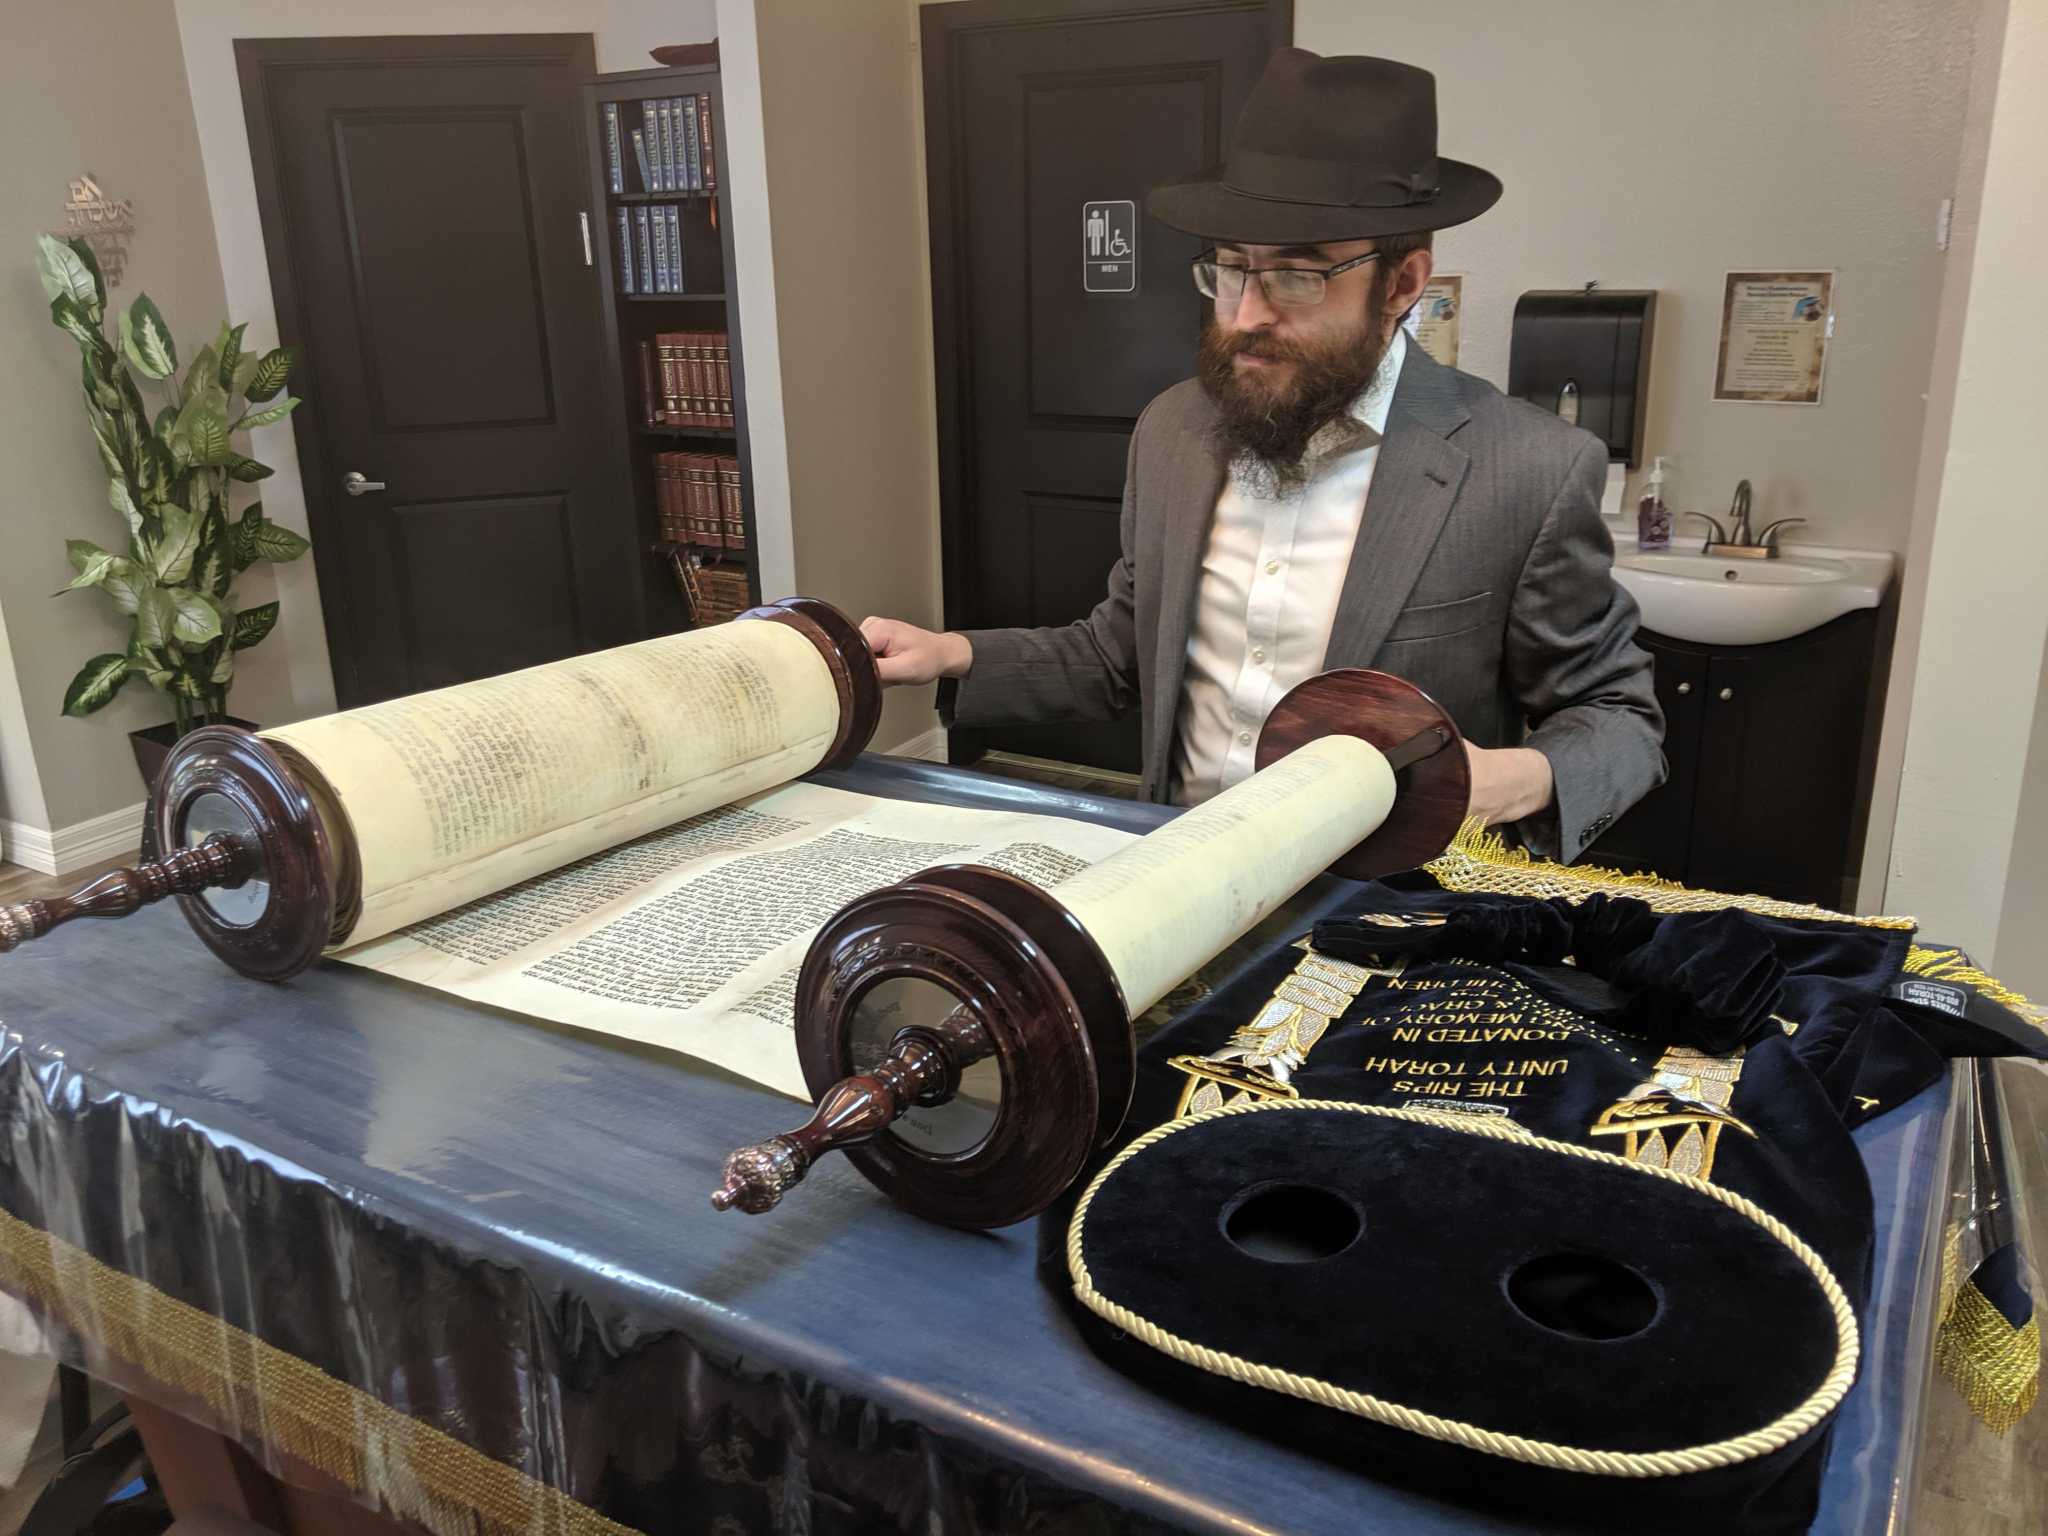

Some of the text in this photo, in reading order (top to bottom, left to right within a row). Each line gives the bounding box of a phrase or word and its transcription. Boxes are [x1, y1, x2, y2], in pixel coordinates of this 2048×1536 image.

[1101, 264, 1119, 273] MEN
[1396, 1012, 1523, 1025] MEMORY
[1392, 1027, 1571, 1043] DONATED IN
[1364, 1056, 1569, 1077] UNITY TORAH
[1391, 1080, 1529, 1098] THE RIPS
